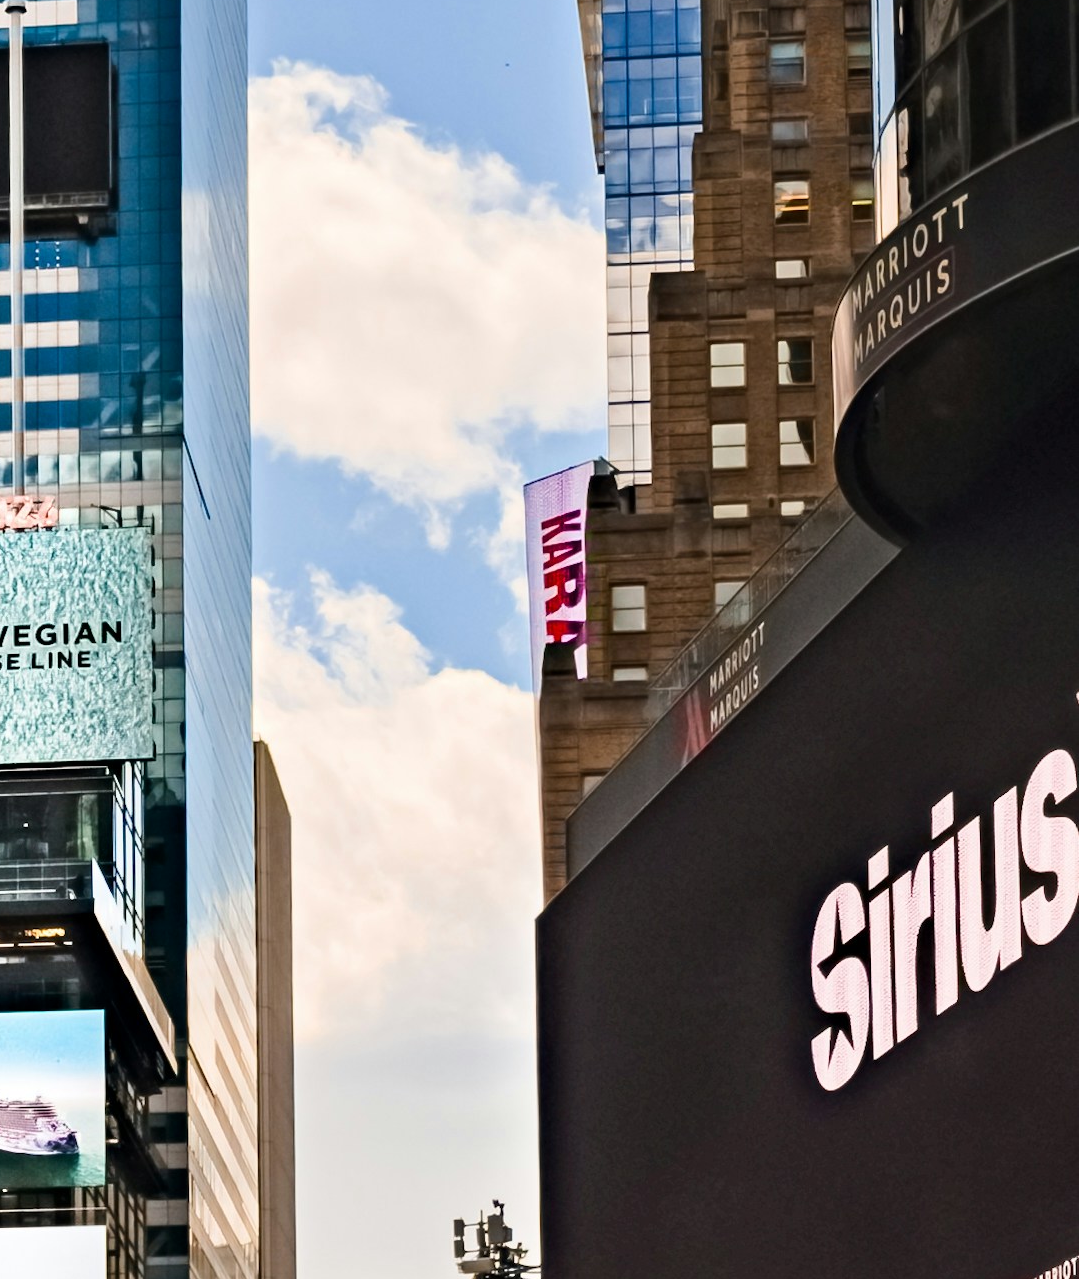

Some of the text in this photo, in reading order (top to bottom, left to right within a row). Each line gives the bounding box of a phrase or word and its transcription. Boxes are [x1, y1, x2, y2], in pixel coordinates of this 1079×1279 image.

[852, 193, 969, 321] MARRIOTT
[854, 259, 950, 371] MARQUIS
[31, 651, 92, 670] LINE
[709, 622, 765, 697] MARRIOTT
[710, 665, 760, 733] MARQUIS
